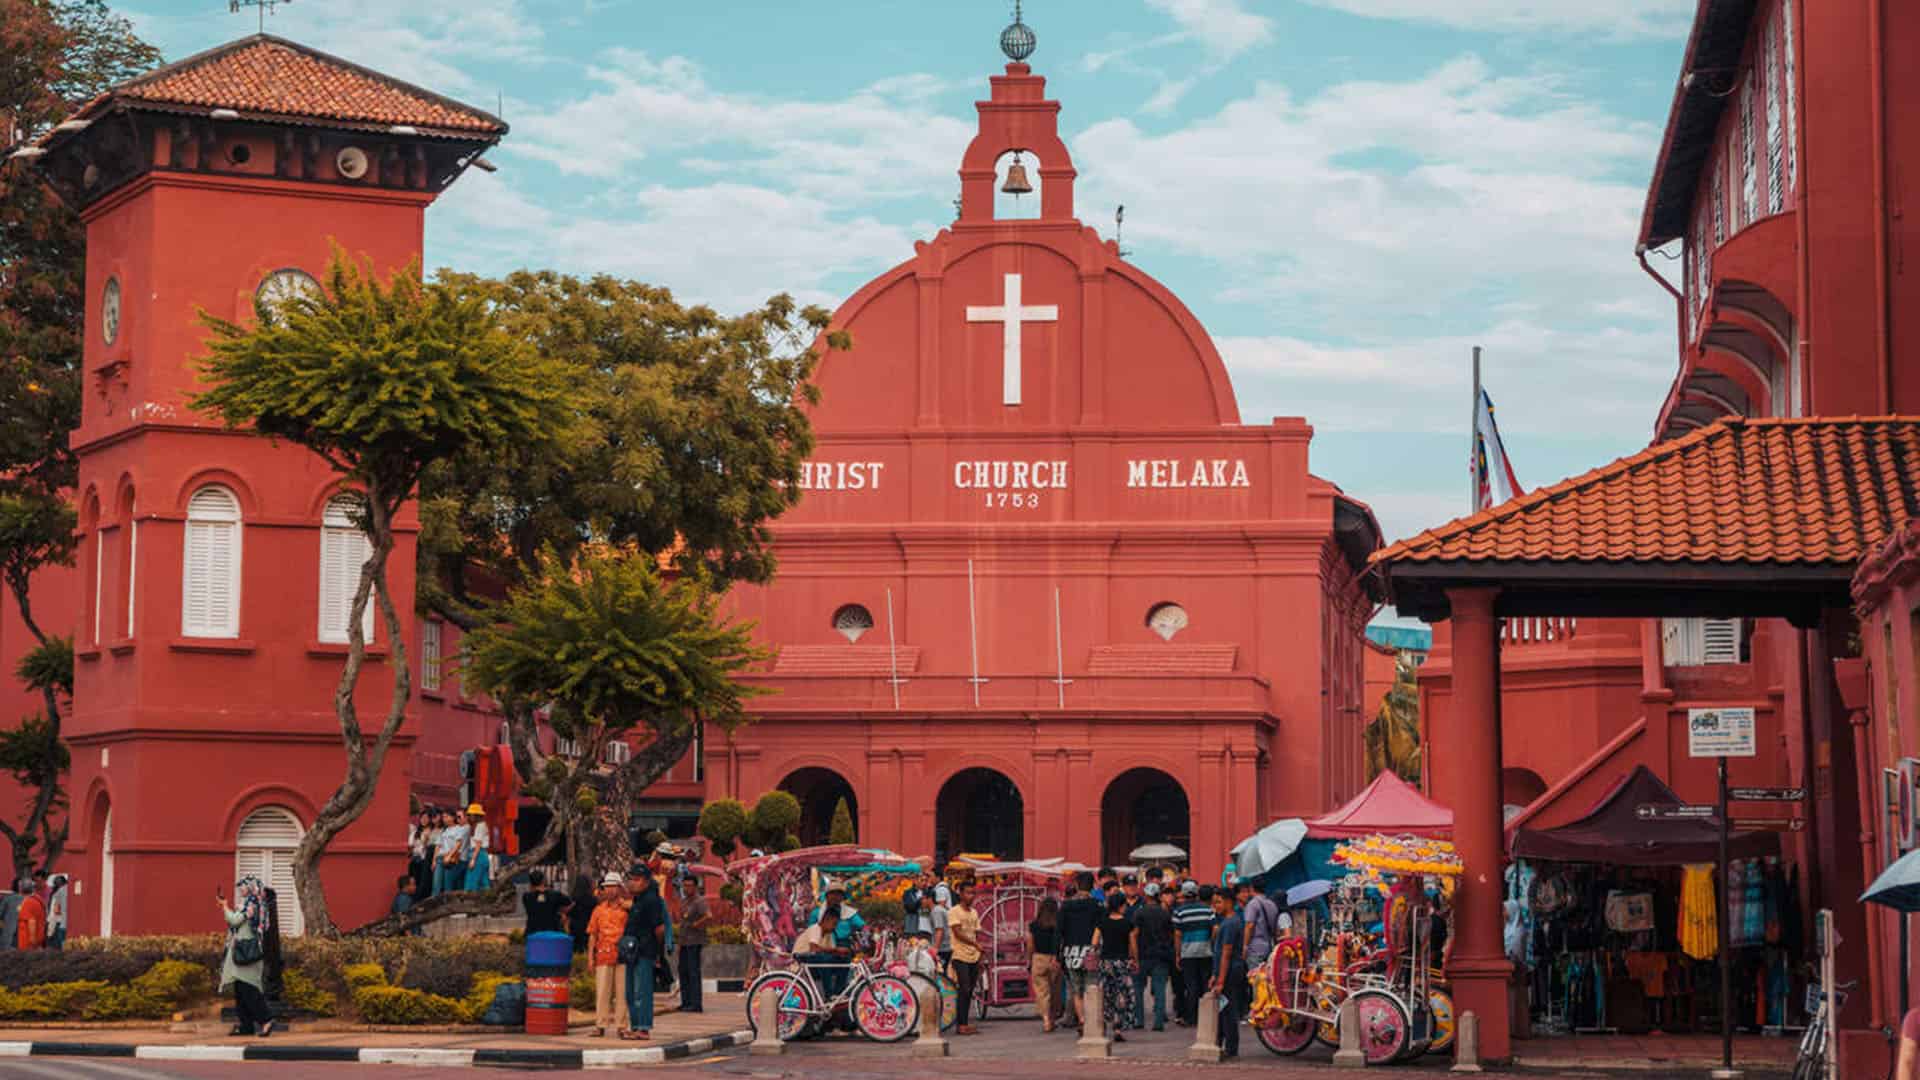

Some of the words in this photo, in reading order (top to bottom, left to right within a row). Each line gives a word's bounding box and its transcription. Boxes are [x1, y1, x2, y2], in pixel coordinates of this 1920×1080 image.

[779, 461, 884, 489] HRIST
[954, 461, 1068, 489] CHURCH
[1126, 459, 1251, 488] MELAKA
[984, 493, 1040, 508] 1753
